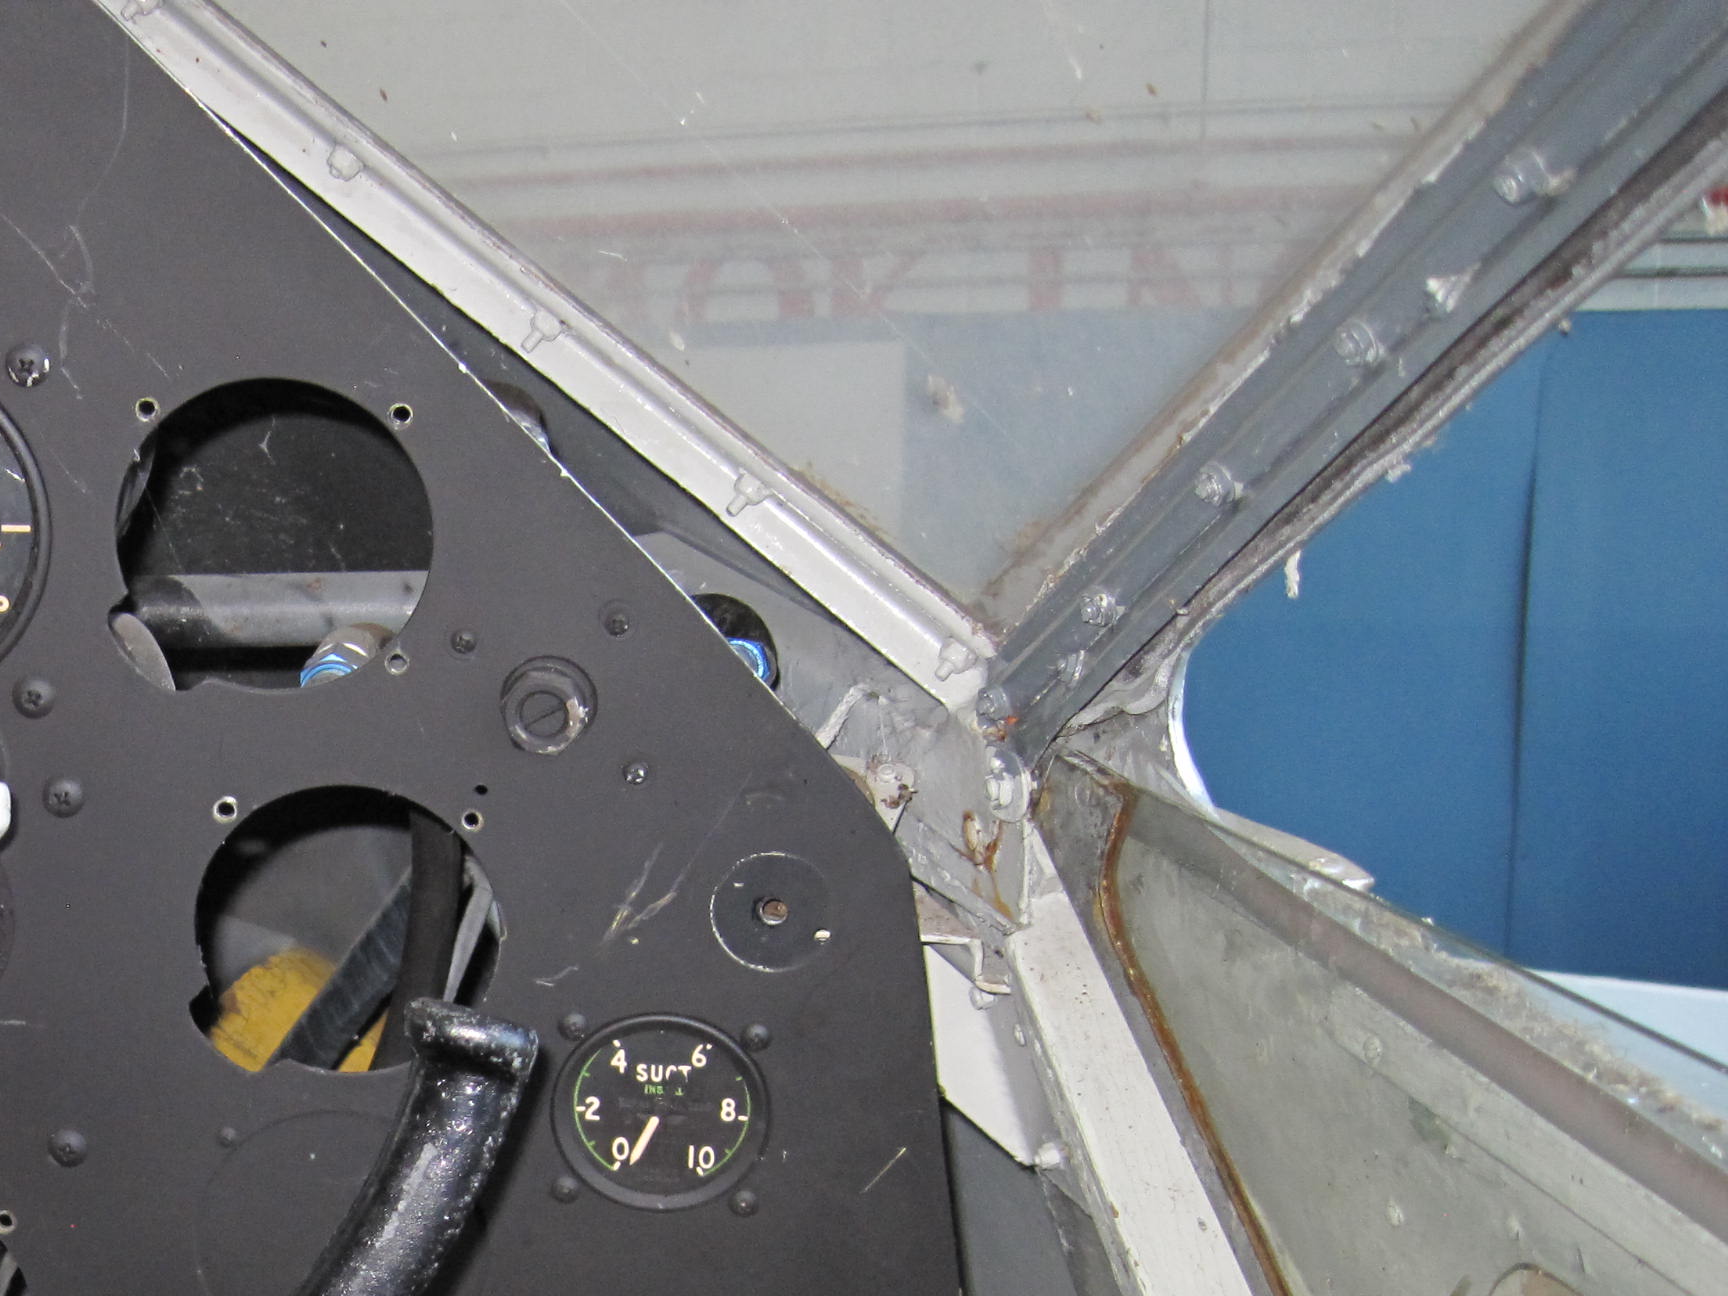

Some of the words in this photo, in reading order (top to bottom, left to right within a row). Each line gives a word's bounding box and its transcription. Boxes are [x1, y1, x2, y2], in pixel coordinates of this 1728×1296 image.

[610, 1049, 627, 1073] 4
[691, 1044, 707, 1067] 6
[584, 1096, 600, 1120] 2
[720, 1098, 736, 1121] 8
[612, 1136, 630, 1160] 0
[688, 1145, 715, 1169] 10
